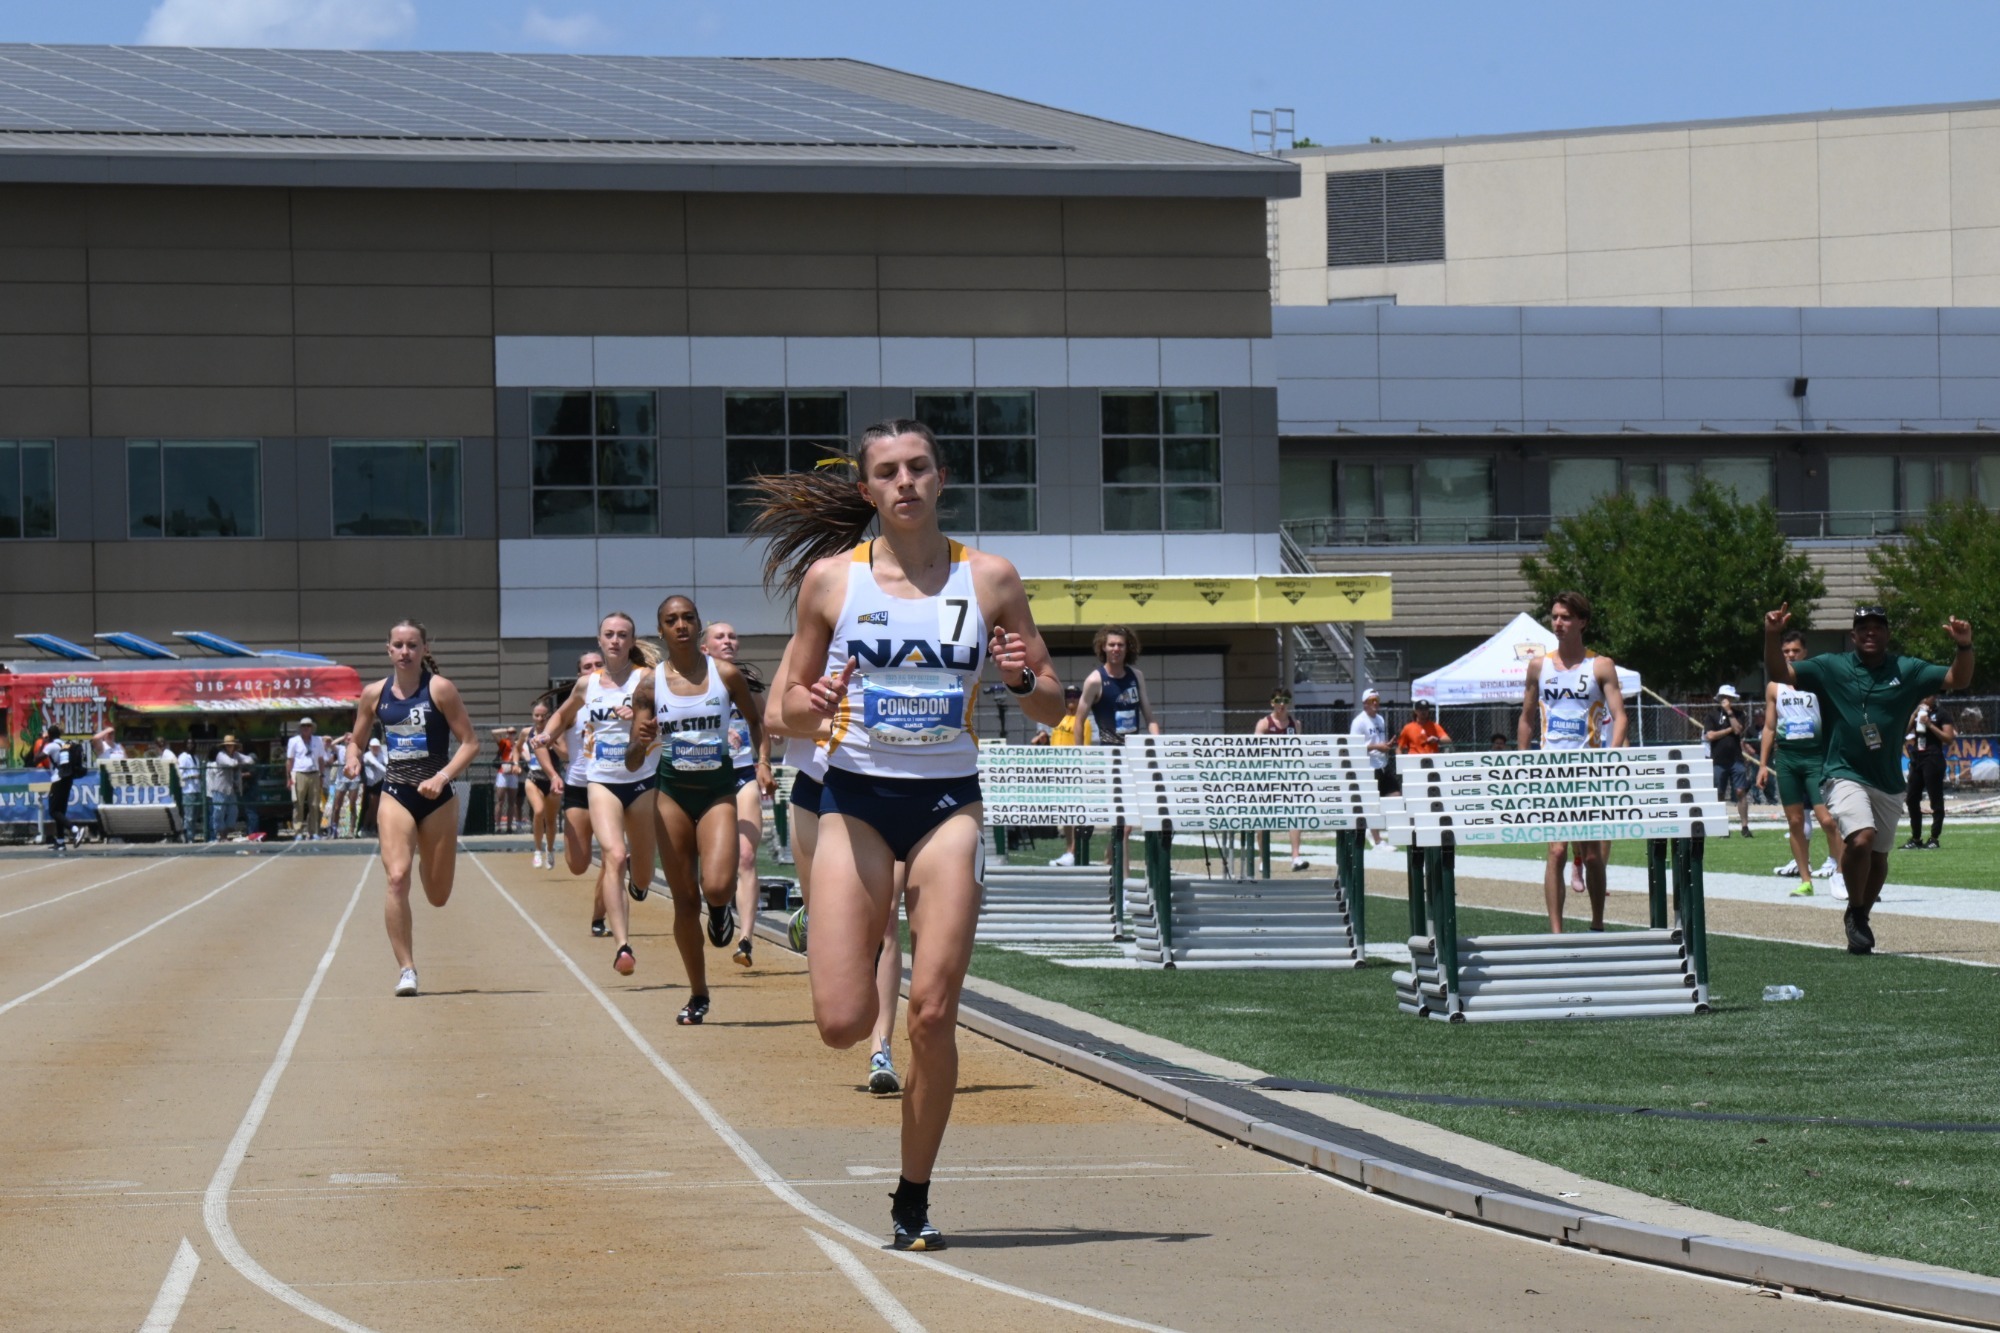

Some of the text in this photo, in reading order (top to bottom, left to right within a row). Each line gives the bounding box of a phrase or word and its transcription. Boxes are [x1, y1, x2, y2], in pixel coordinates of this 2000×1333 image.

[945, 598, 968, 642] 7
[846, 638, 980, 671] NAU
[195, 678, 312, 692] 916-402-3473
[1577, 674, 1589, 692] 5
[46, 686, 99, 698] CALIFORNIA
[1132, 688, 1138, 699] 4
[1544, 688, 1589, 700] NAU
[877, 697, 949, 716] CONGDON
[1793, 697, 1804, 706] STA
[1806, 695, 1813, 708] 2
[42, 697, 107, 734] STREET
[411, 709, 421, 726] 3
[590, 707, 618, 721] NA
[658, 720, 679, 735] SAC
[681, 714, 722, 732] STATE
[1192, 738, 1301, 746] SACRAMENTO
[675, 745, 718, 756] DOMINIQUE
[1193, 748, 1303, 758] SACRAMENTO
[1195, 760, 1304, 769] SACRAMENTO
[1480, 751, 1622, 767] SACRAMENTO
[1200, 772, 1309, 781] SACRAMENTO
[1488, 765, 1630, 780] SACRAMENTO
[1202, 783, 1313, 792] SACRAMENTO
[1487, 780, 1629, 795] SACRAMENTO
[1204, 794, 1315, 804] SACRAMENTO
[1491, 795, 1633, 810] SACRAMENTO
[1206, 806, 1316, 815] SACRAMENTO
[1500, 808, 1642, 824] SACRAMENTO
[992, 814, 1086, 824] SACRAMENTO
[1209, 817, 1320, 830] SACRAMENTO
[1501, 824, 1644, 843] SACRAMENTO
